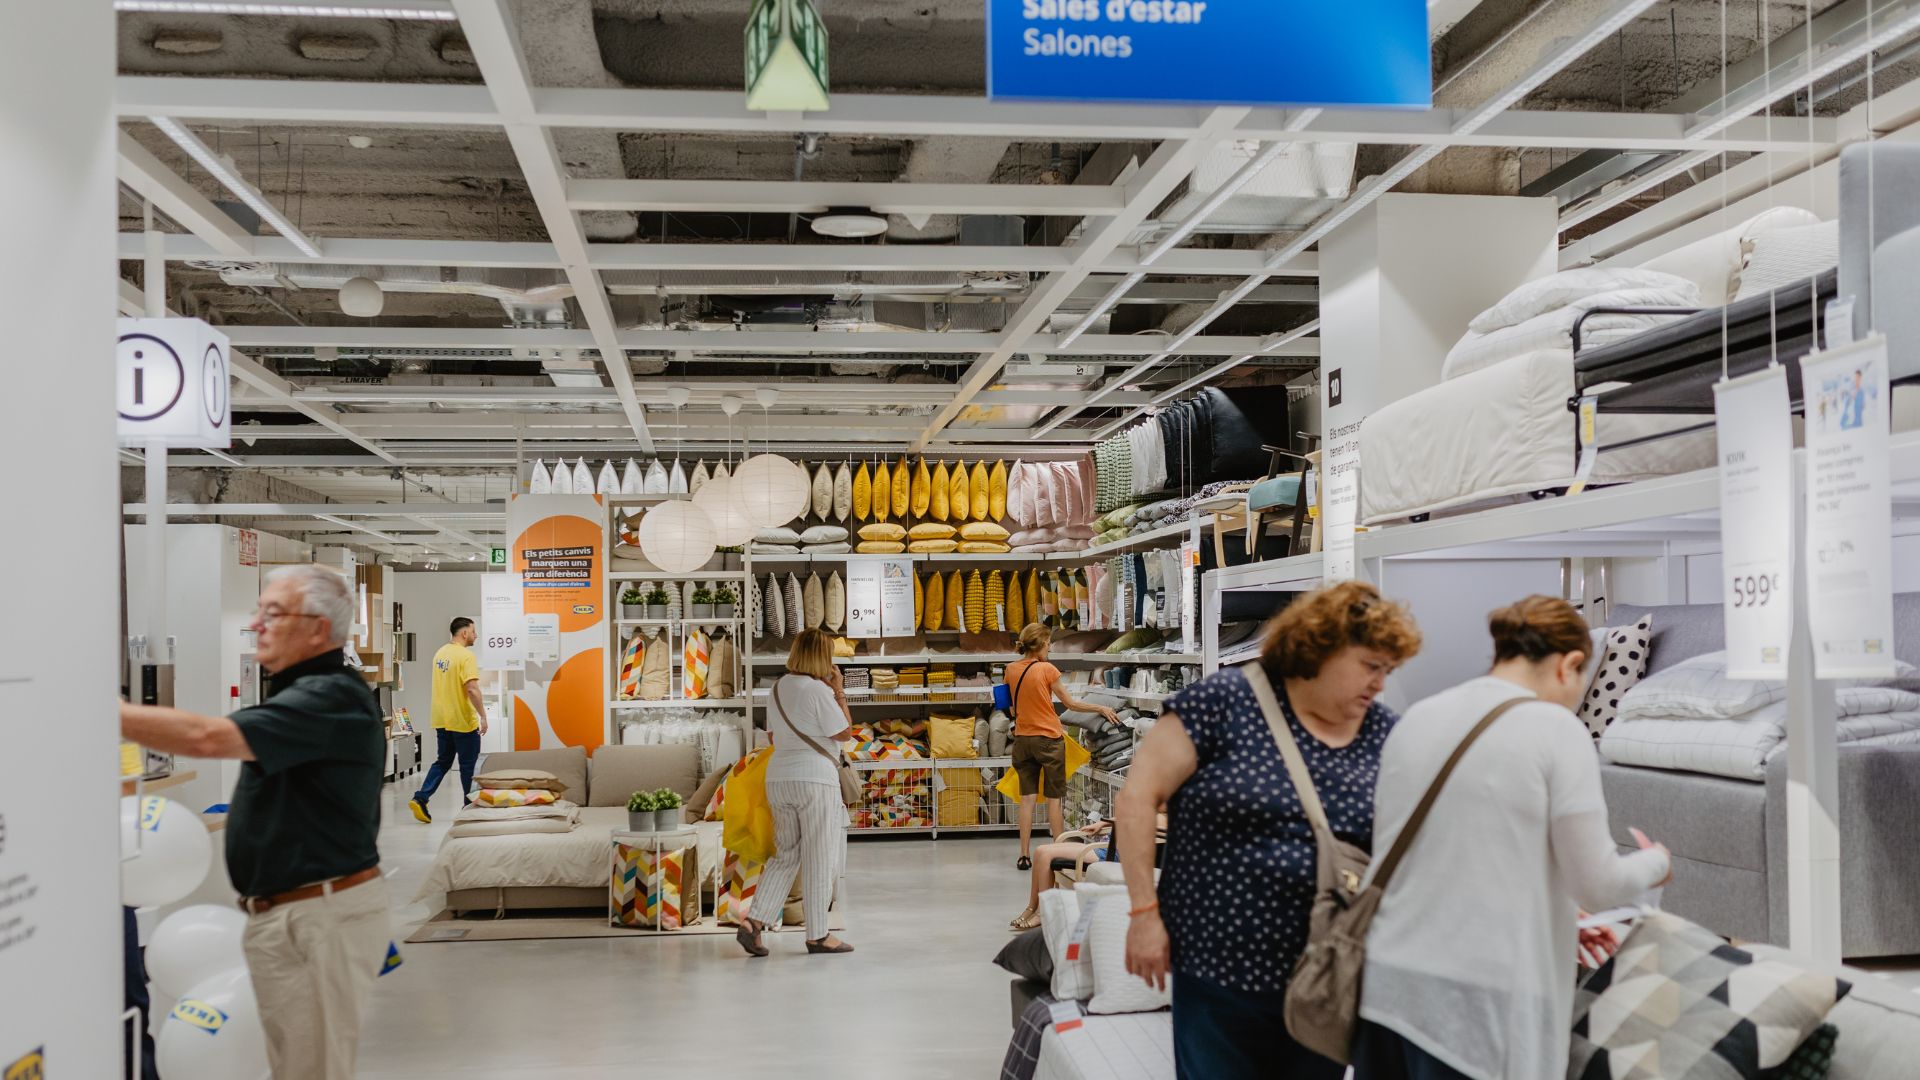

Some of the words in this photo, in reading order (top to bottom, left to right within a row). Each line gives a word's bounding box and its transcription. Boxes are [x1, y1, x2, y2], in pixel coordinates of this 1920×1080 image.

[1022, 0, 1100, 21] Sales
[1023, 27, 1133, 58] Salones
[340, 376, 383, 384] LIMAVER
[1330, 378, 1340, 398] 10
[525, 550, 537, 558] Els
[538, 548, 563, 559] petits
[564, 547, 591, 556] canvis
[524, 571, 545, 579] gran
[545, 570, 588, 578] diferència
